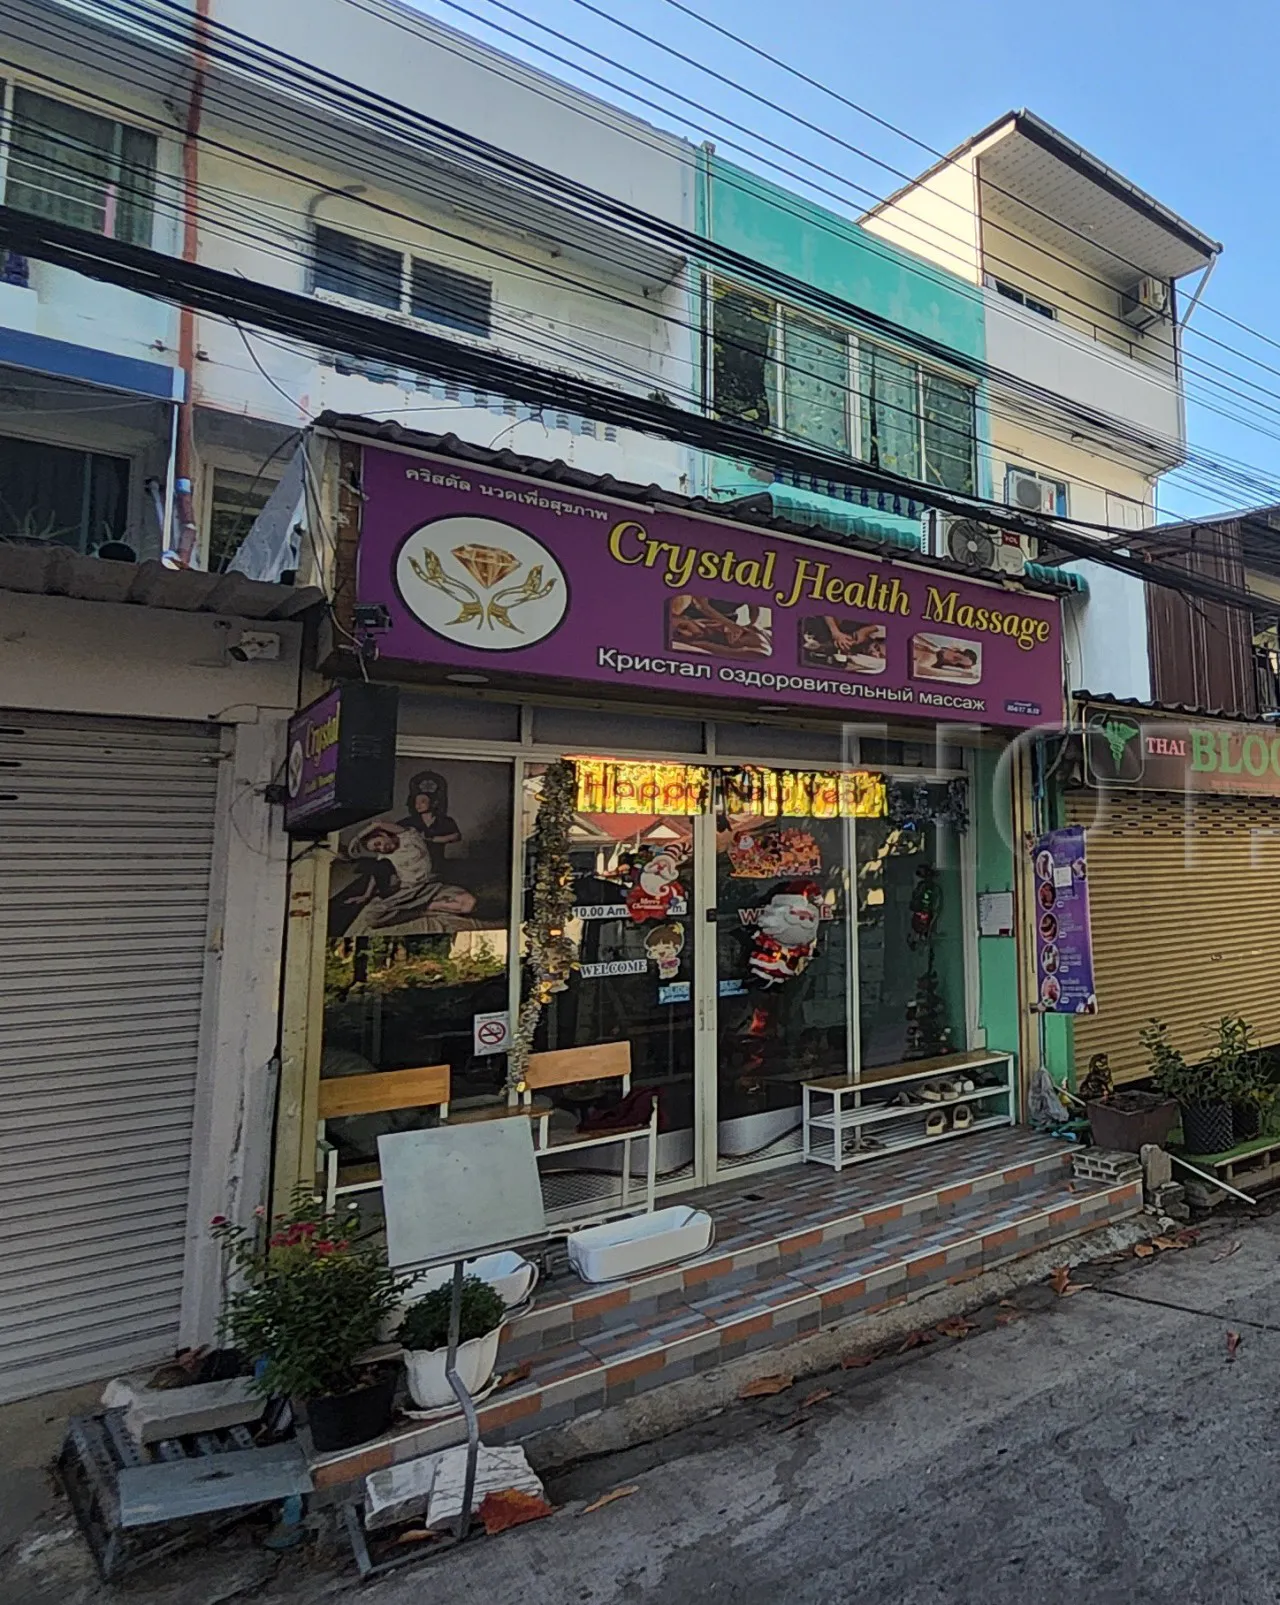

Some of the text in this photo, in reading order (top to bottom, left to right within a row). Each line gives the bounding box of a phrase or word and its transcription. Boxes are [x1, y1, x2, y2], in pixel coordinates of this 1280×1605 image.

[608, 520, 1051, 650] Crystal Health Massage
[597, 647, 986, 712] Кристал оздоровительный массаж
[1145, 736, 1186, 757] THAI
[583, 769, 707, 808] Happy
[574, 906, 604, 917] 10.00
[607, 905, 630, 916] Am.
[580, 960, 647, 977] WELCOME
